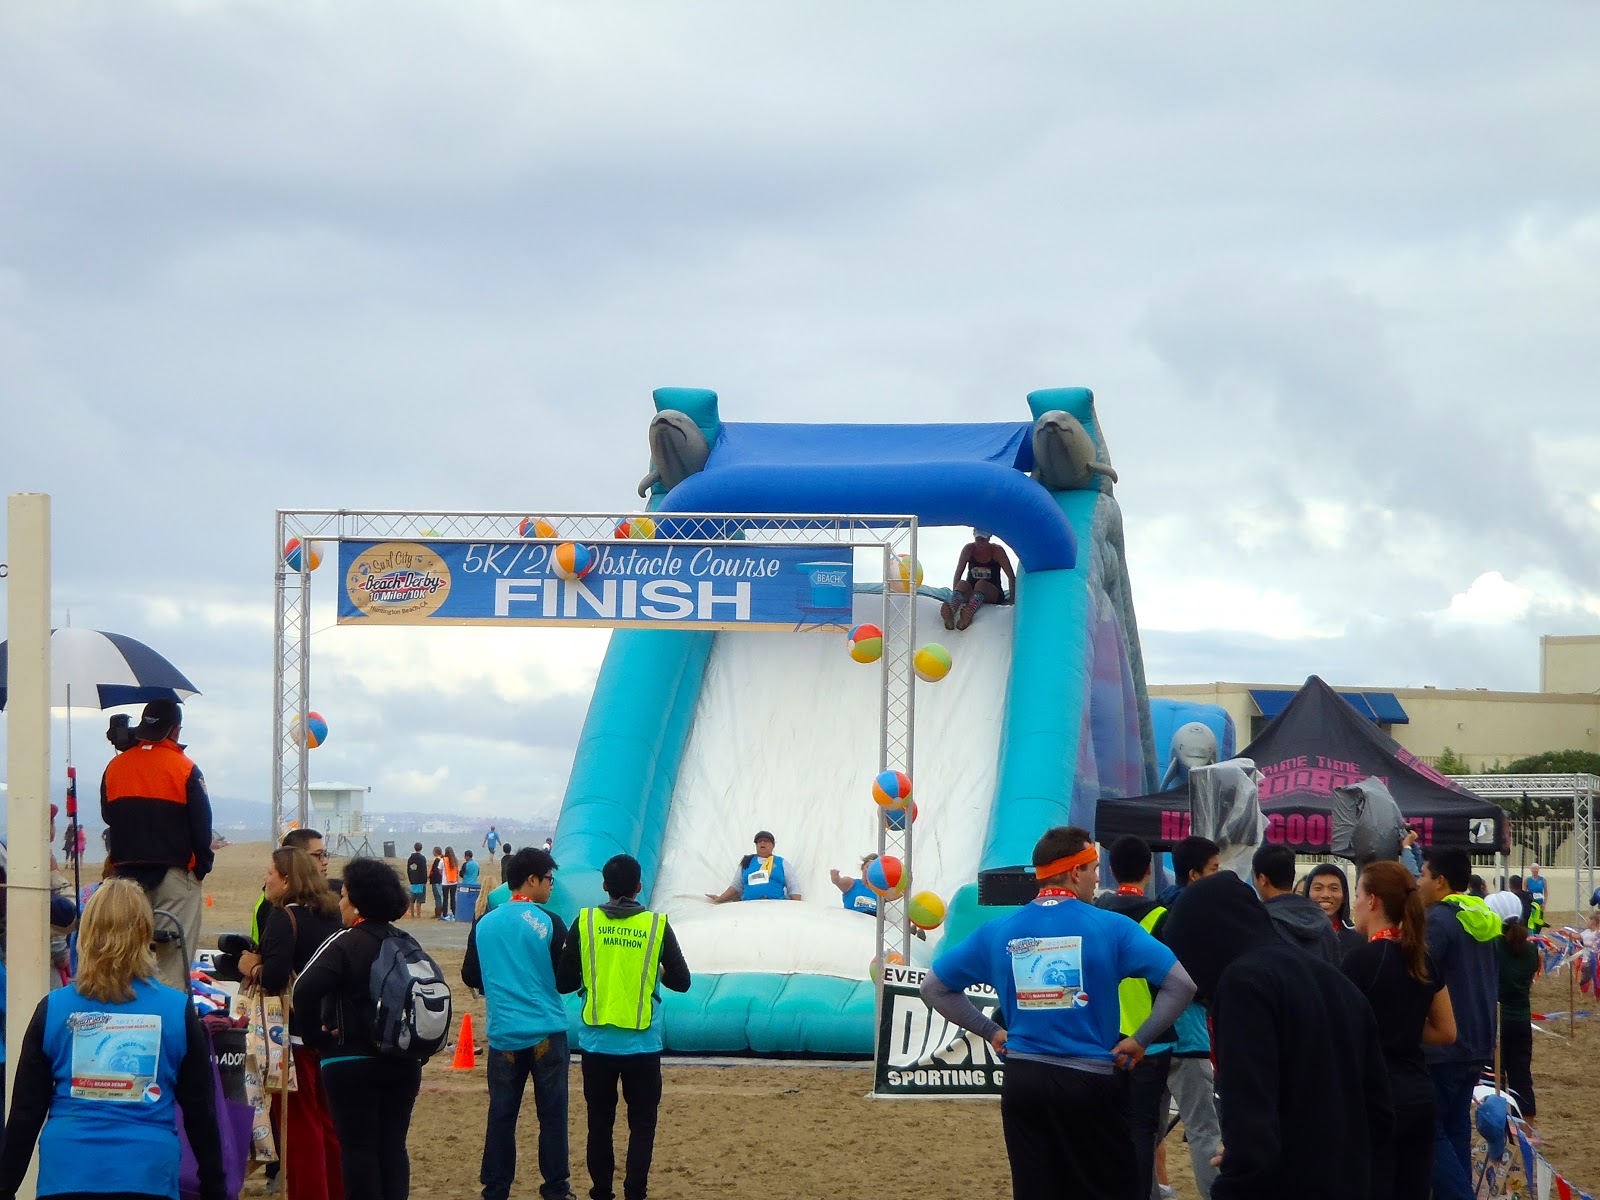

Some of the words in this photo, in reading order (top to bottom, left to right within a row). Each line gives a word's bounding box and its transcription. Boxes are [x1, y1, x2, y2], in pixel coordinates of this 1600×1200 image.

[372, 550, 394, 573] Surf
[395, 551, 413, 569] City
[689, 546, 781, 577] Course
[366, 573, 401, 590] Beach
[404, 571, 440, 593] Derby
[817, 573, 840, 583] BEACH
[369, 591, 379, 601] 10
[380, 589, 426, 601] Miler/10K
[494, 578, 751, 620] FINISH
[1315, 755, 1361, 773] TIME
[1265, 813, 1333, 846] GOO
[598, 926, 616, 935] SURF
[617, 927, 632, 936] CITY
[633, 929, 648, 939] USA
[603, 937, 643, 949] MARATHON
[887, 1069, 986, 1086] SPORTING
